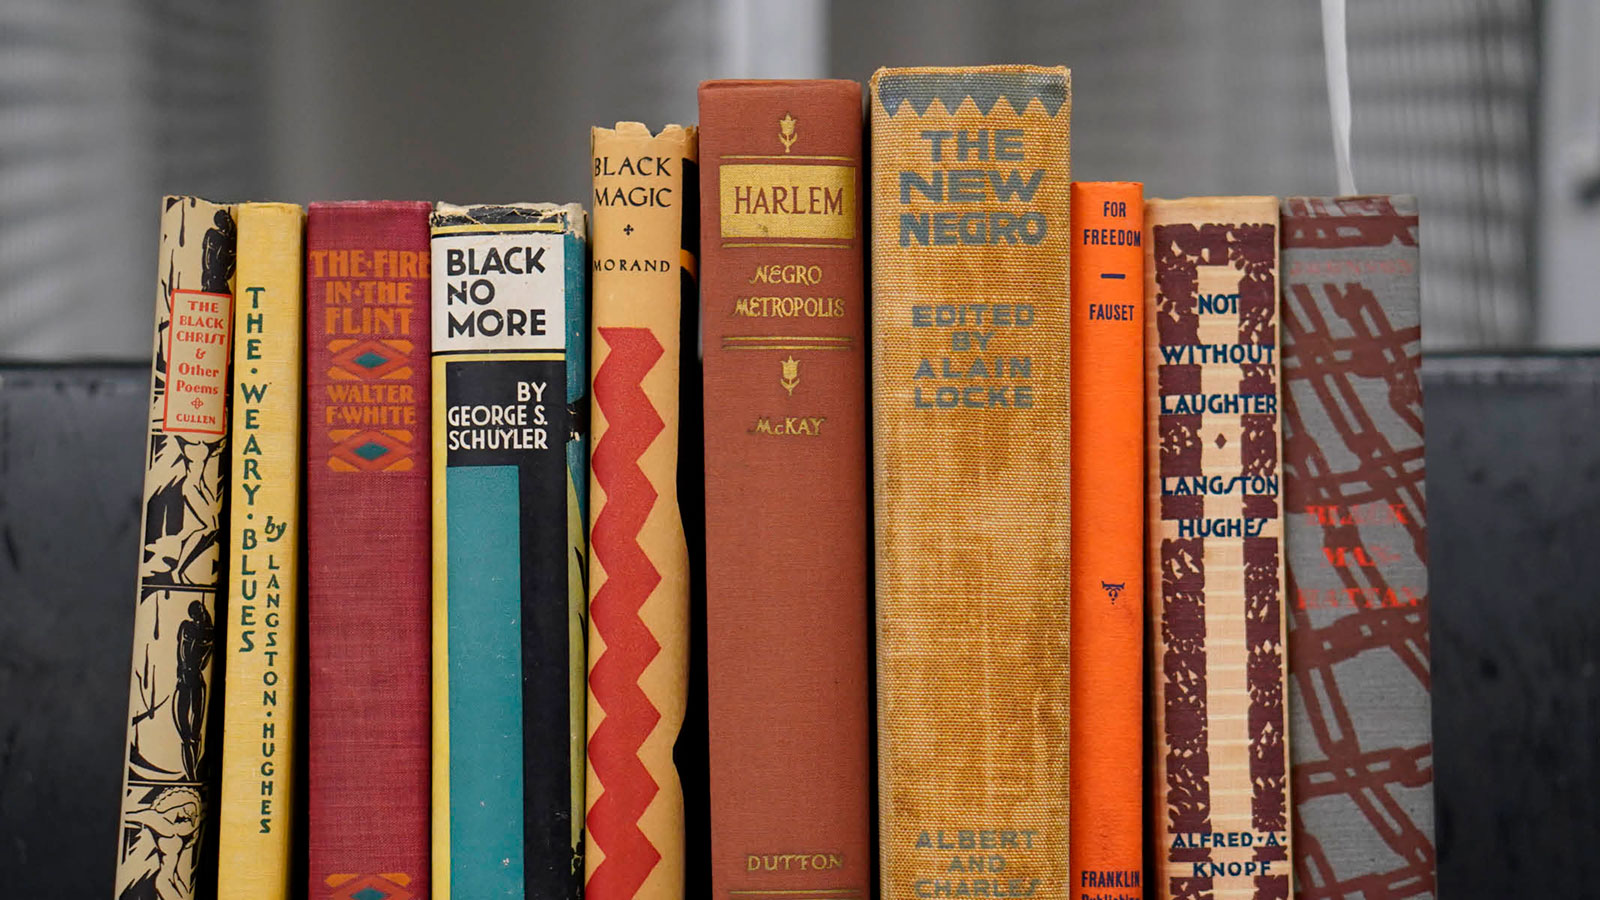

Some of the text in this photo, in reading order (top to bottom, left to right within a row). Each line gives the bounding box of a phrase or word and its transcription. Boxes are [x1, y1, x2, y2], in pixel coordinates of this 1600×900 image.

[921, 129, 1024, 162] THE
[595, 156, 671, 177] BLACK
[595, 186, 672, 208] MAGIC
[899, 169, 1046, 204] NEW
[734, 186, 844, 216] HARLEM
[1103, 201, 1126, 218] FOR
[899, 211, 1048, 247] NEGRO
[1083, 229, 1141, 247] FREEDOM
[310, 250, 431, 278] THE FIRE
[447, 247, 546, 276] BLACK
[593, 258, 671, 273] MORAND
[749, 264, 823, 286] NEGRO
[325, 281, 413, 304] IN THE
[447, 279, 495, 306] NO
[187, 300, 219, 314] THE
[733, 297, 845, 318] METROPOLIS
[1089, 303, 1135, 321] FAUSET
[1199, 294, 1240, 315] NOT
[179, 315, 224, 330] BLACK
[325, 307, 414, 335] FLINT
[448, 309, 546, 338] MORE
[912, 304, 1034, 327] EDITED
[176, 331, 226, 346] CHRIST
[952, 331, 994, 352] BY
[195, 349, 206, 360] &
[1160, 344, 1275, 364] WITHOUT
[178, 362, 220, 379] Other
[913, 357, 1031, 380] ALAIN
[176, 379, 219, 395] Poems
[326, 385, 414, 403] WALTER
[517, 381, 547, 402] BY
[914, 386, 1034, 409] LOCKE
[343, 406, 416, 424] WHITE
[1160, 394, 1277, 415] LAUGHTER
[176, 413, 216, 426] CULLEN
[447, 405, 527, 427] GEORGE
[754, 416, 826, 437] McKAY
[448, 429, 549, 450] SCHUYLER
[239, 287, 268, 653] THE WEARY BLUES
[1161, 475, 1279, 496] LANGSTON
[1178, 518, 1268, 539] HUGHES
[258, 515, 288, 835] by LANGSTON HUGHES
[914, 829, 1040, 851] ALBERT
[1171, 832, 1253, 849] ALFRED
[747, 853, 845, 872] DUTTON
[946, 855, 1007, 874] AND
[1192, 861, 1272, 878] KNOPF
[914, 877, 1042, 900] CHARLES
[1081, 870, 1140, 888] FRANKLIN
